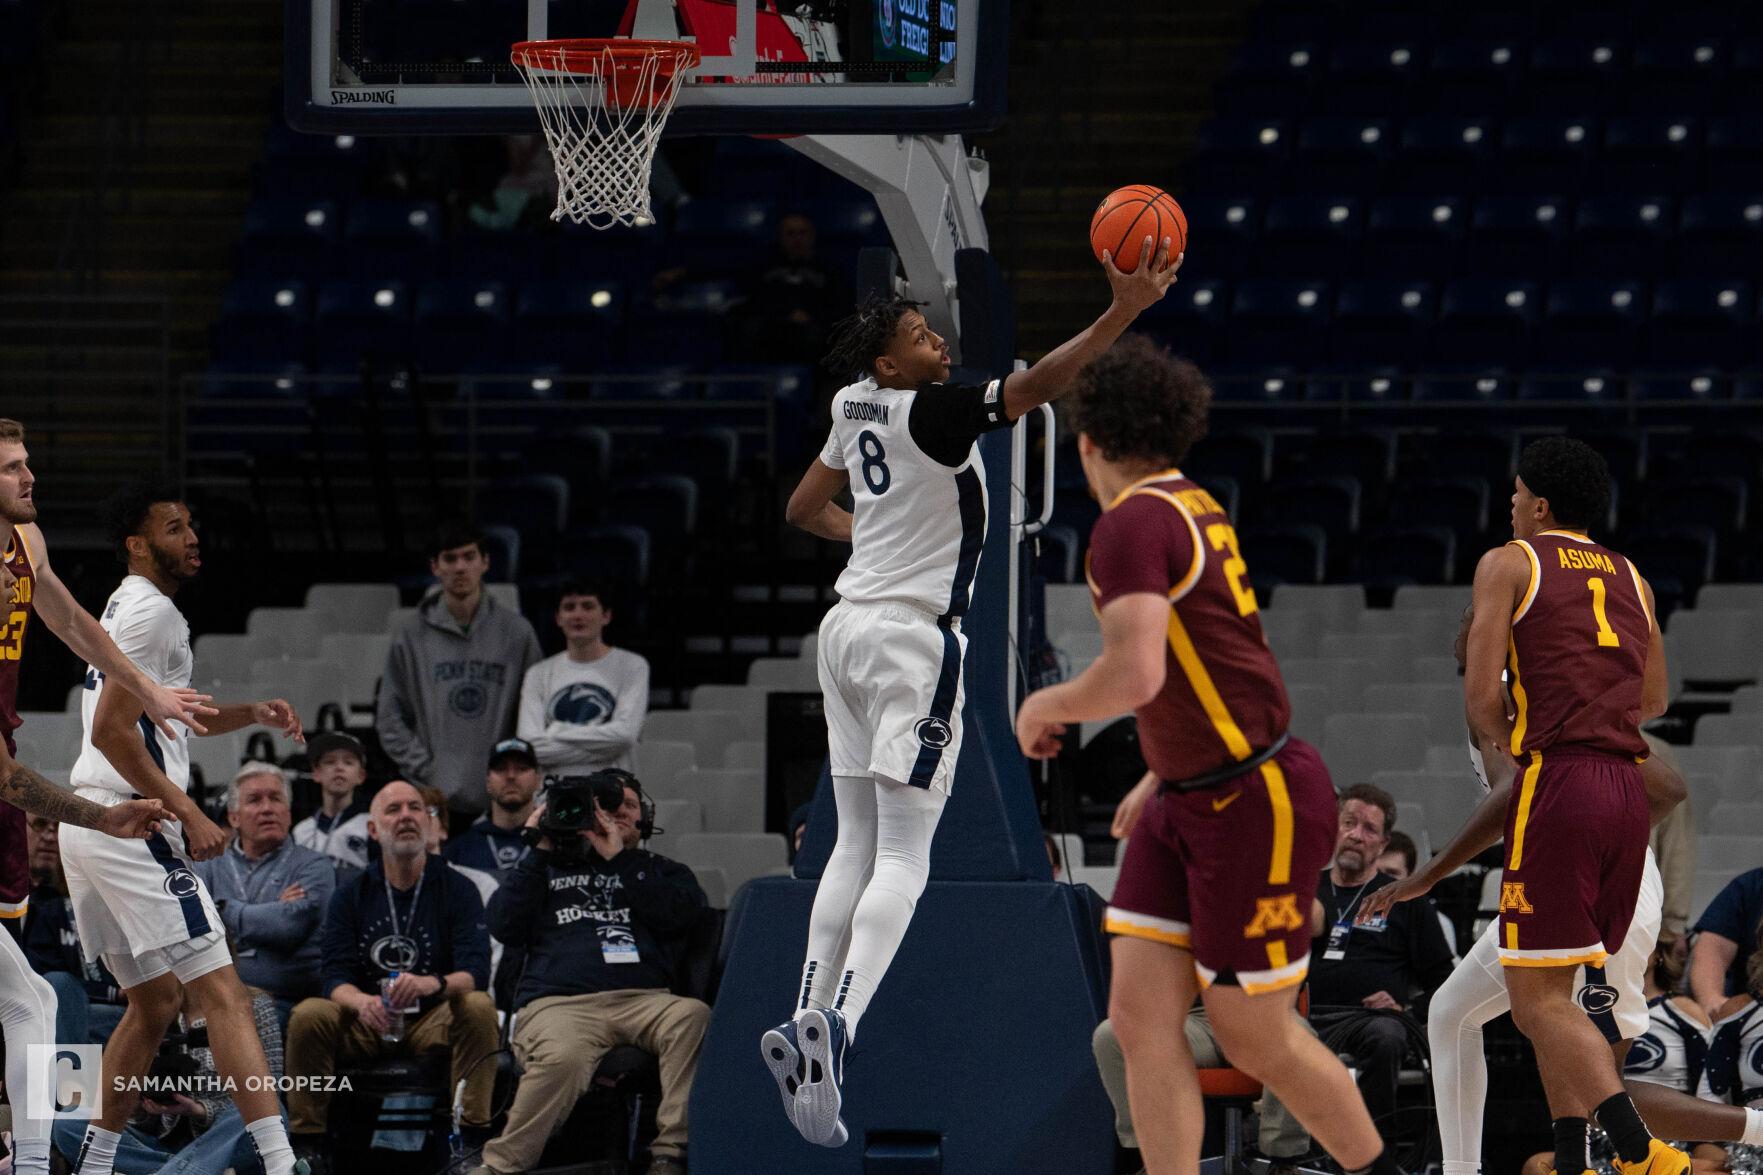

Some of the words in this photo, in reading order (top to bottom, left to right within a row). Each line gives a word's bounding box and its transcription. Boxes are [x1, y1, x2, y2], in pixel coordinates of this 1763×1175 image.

[331, 90, 395, 105] SPALDING
[843, 400, 889, 426] GOODMAN
[858, 429, 891, 496] 8
[1557, 547, 1617, 576] ASUMA
[1586, 577, 1620, 647] 1
